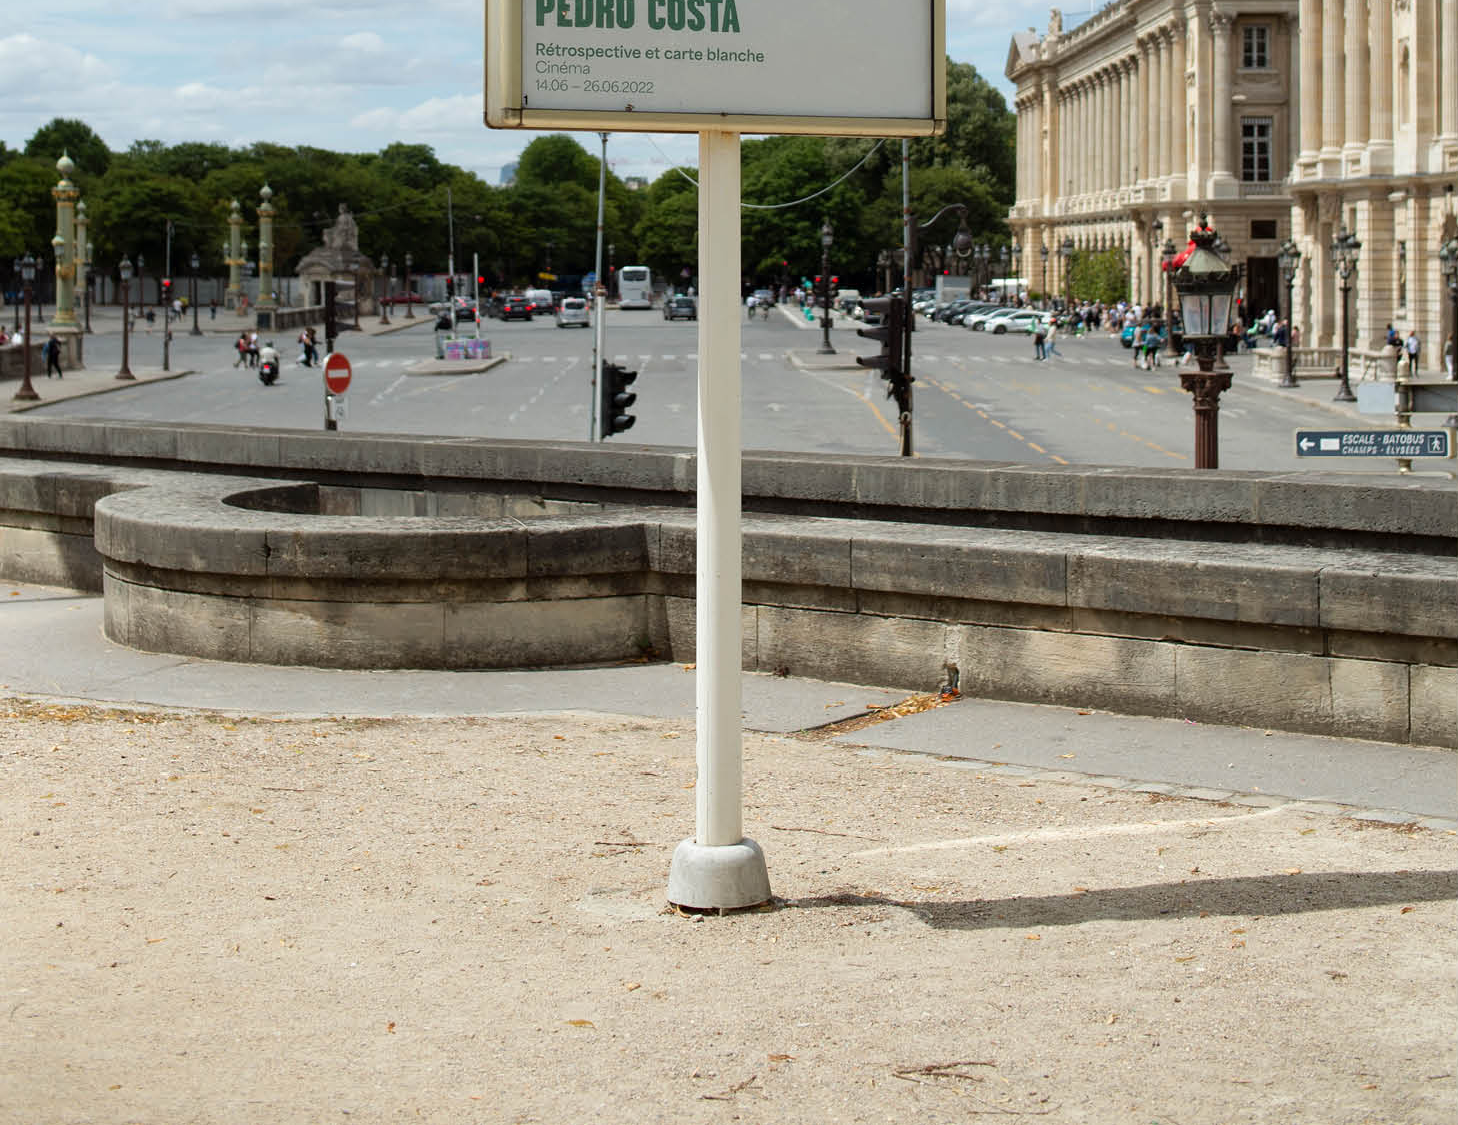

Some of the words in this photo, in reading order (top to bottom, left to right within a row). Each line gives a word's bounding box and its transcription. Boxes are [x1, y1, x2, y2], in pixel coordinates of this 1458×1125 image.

[535, 42, 641, 60] Rétrospective
[645, 47, 660, 60] et
[664, 49, 703, 61] carte
[707, 48, 765, 63] blanche
[535, 60, 591, 75] Cinéma
[535, 79, 568, 92] 14.06
[583, 80, 654, 94] 26.06.2022
[1342, 434, 1375, 445] ESCALE
[1383, 434, 1425, 445] BATOBUS
[1342, 445, 1378, 455] CHAMPS
